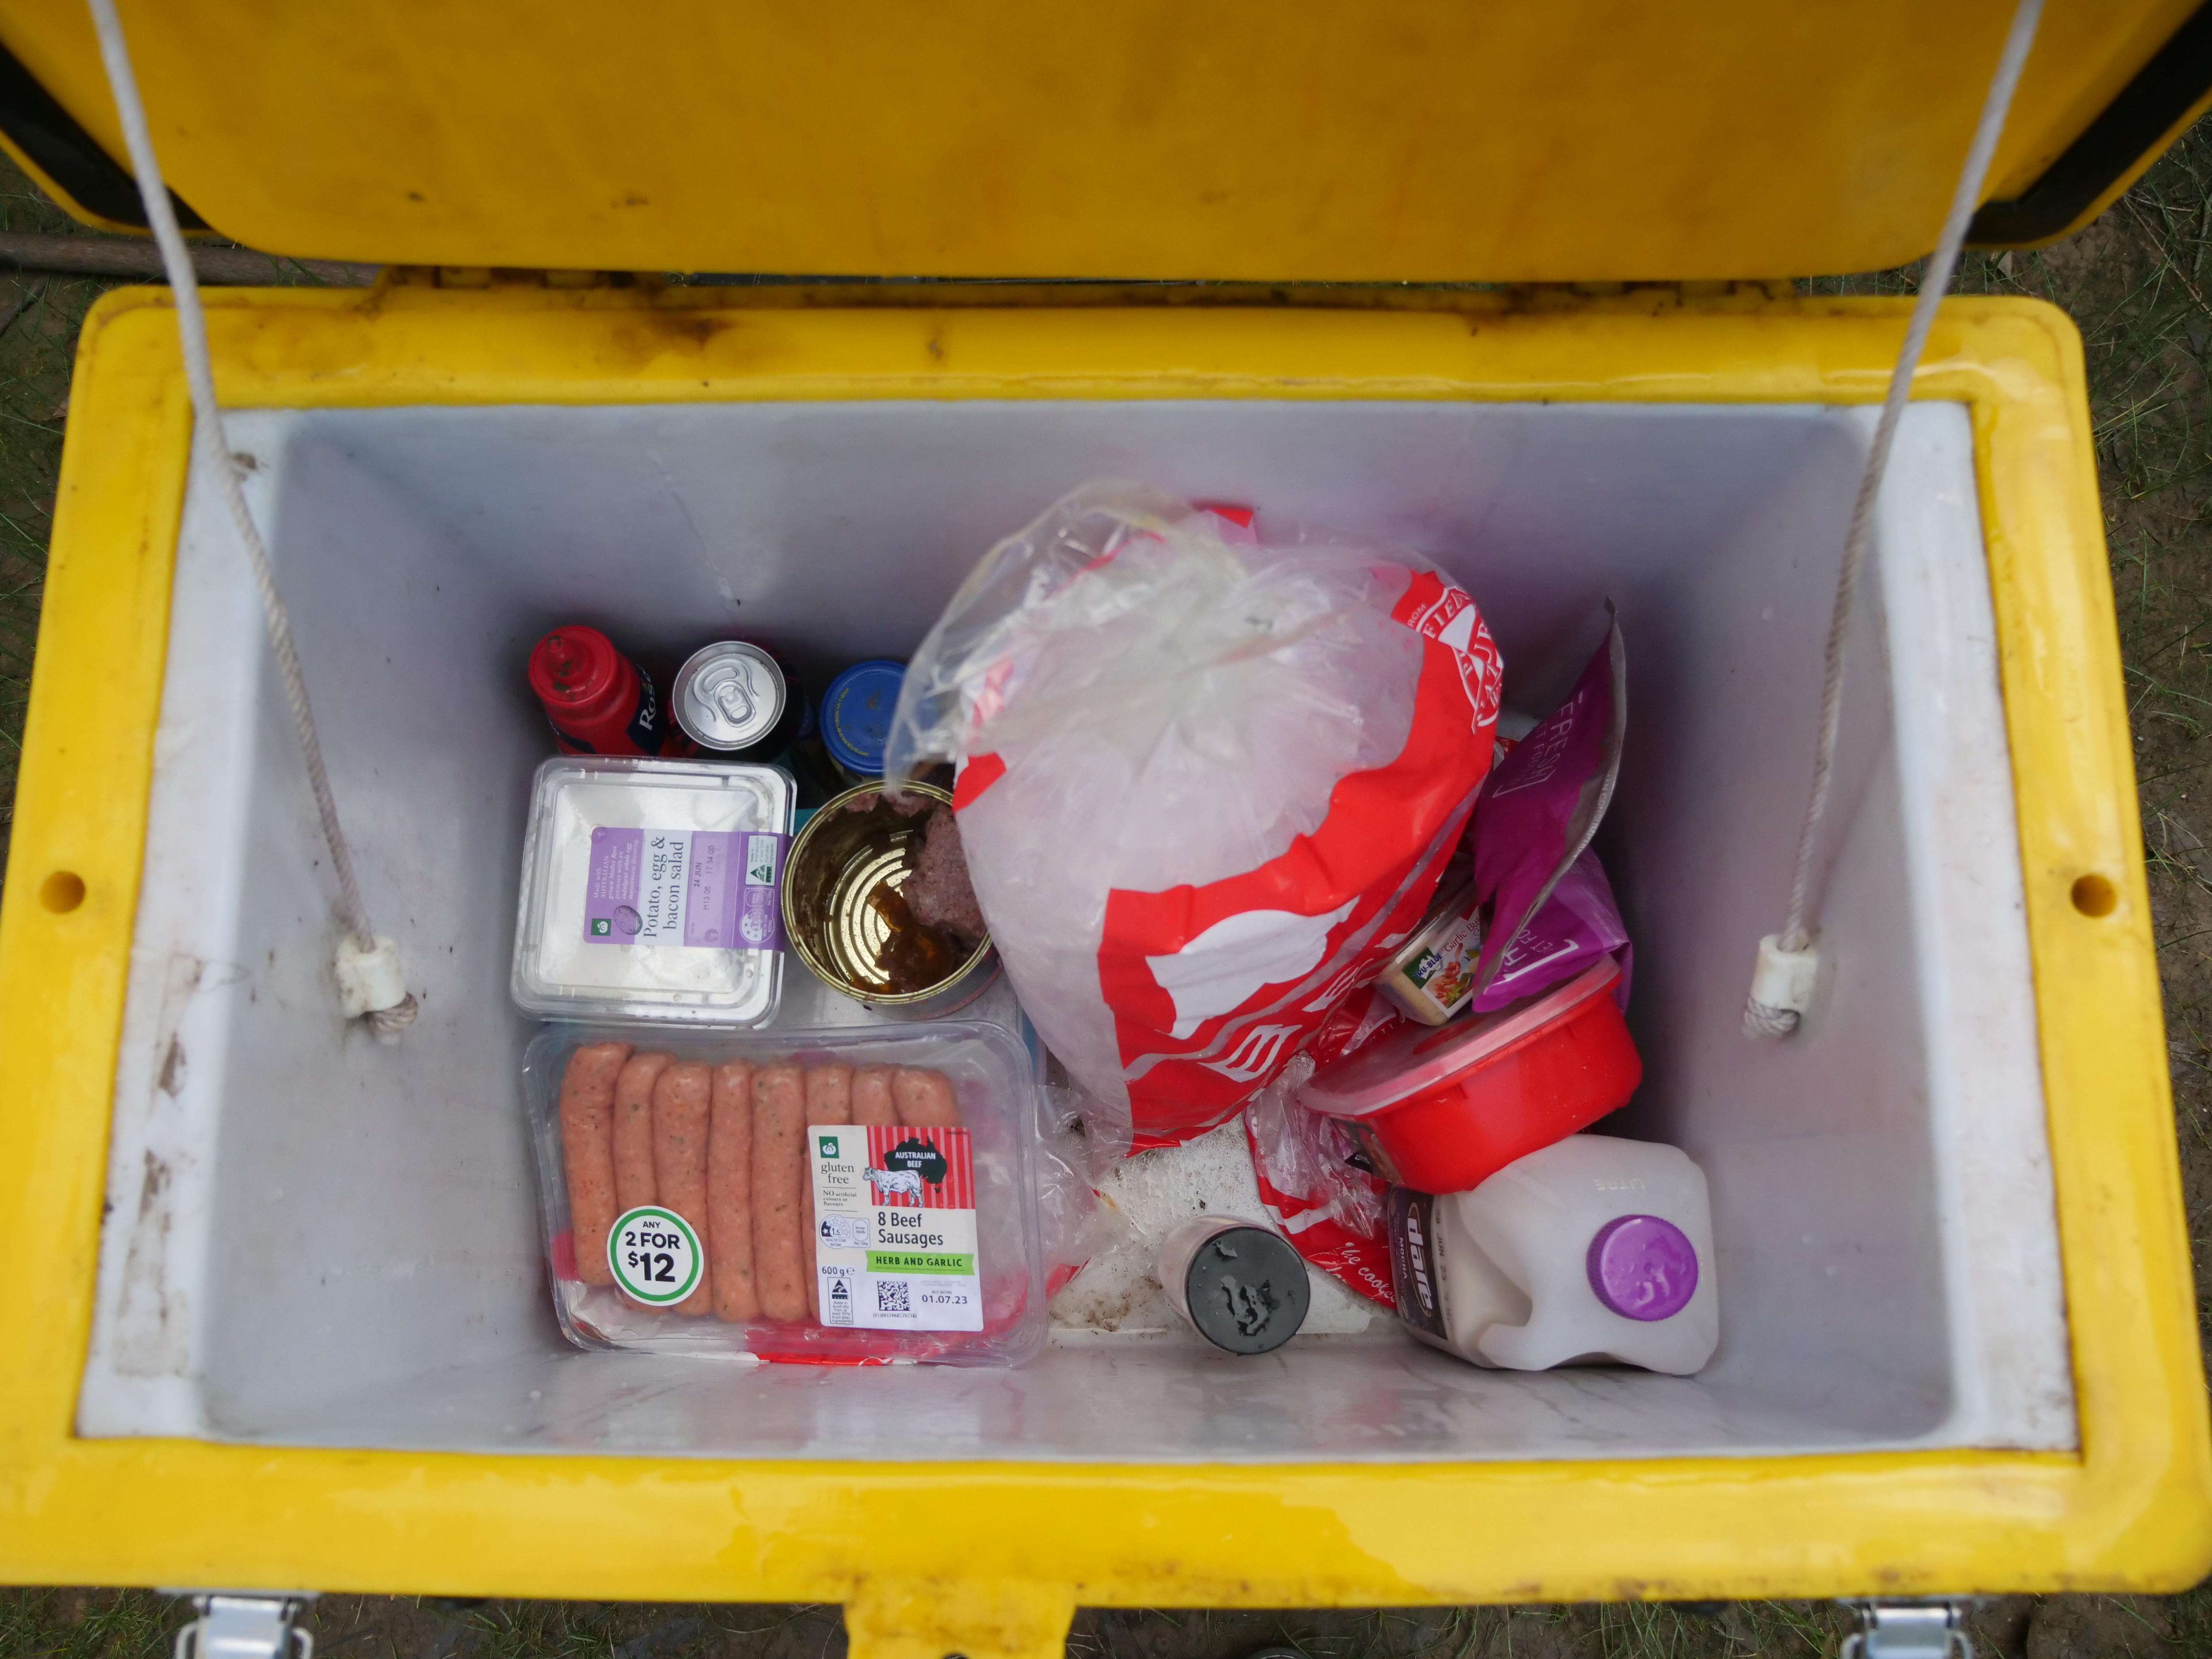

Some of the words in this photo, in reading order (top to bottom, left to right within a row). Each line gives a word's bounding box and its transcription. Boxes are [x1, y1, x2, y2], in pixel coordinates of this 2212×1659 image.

[1407, 603, 1426, 628] ROM
[1536, 723, 1547, 739] ET
[651, 836, 665, 849] &
[652, 853, 668, 880] egg
[668, 842, 684, 880] salad
[694, 879, 700, 887] 24
[643, 885, 663, 937] Potato,
[663, 885, 680, 929] bacon
[1444, 929, 1467, 952] Garlic
[1413, 952, 1443, 979] TRU-BLUE
[821, 1162, 854, 1174] gluten
[828, 1173, 849, 1184] free
[878, 1211, 886, 1226] 8
[891, 1212, 922, 1228] Beef
[625, 1231, 637, 1246] 2
[641, 1232, 681, 1249] FOR
[878, 1229, 944, 1248] Sausages
[1437, 1233, 1445, 1257] JUN
[628, 1251, 676, 1283] $12
[876, 1256, 900, 1265] HERB
[904, 1257, 923, 1266] AND
[927, 1258, 962, 1267] GARLIC
[1399, 1237, 1408, 1279] MOCHA
[1408, 1217, 1433, 1310] dare
[822, 1266, 837, 1275] 600
[922, 1295, 968, 1304] 01.07.23
